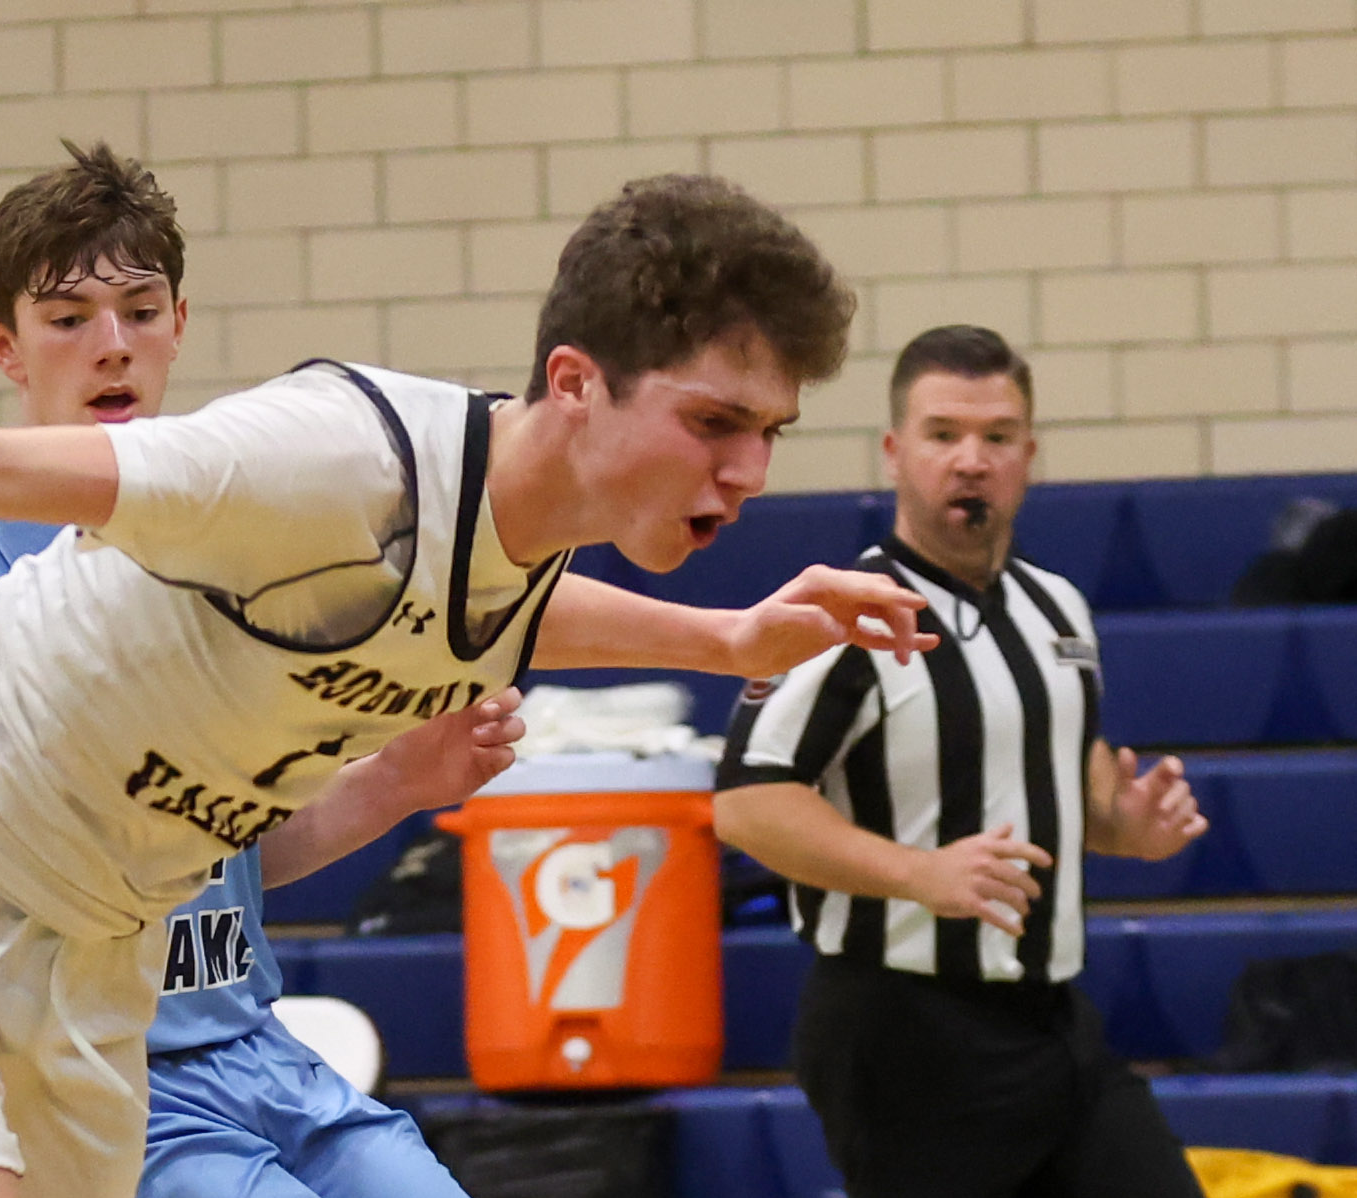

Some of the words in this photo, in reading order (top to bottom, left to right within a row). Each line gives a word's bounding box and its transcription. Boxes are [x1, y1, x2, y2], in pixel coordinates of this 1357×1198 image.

[126, 750, 294, 850] VALLE
[535, 843, 616, 930] G
[159, 906, 255, 996] AME
